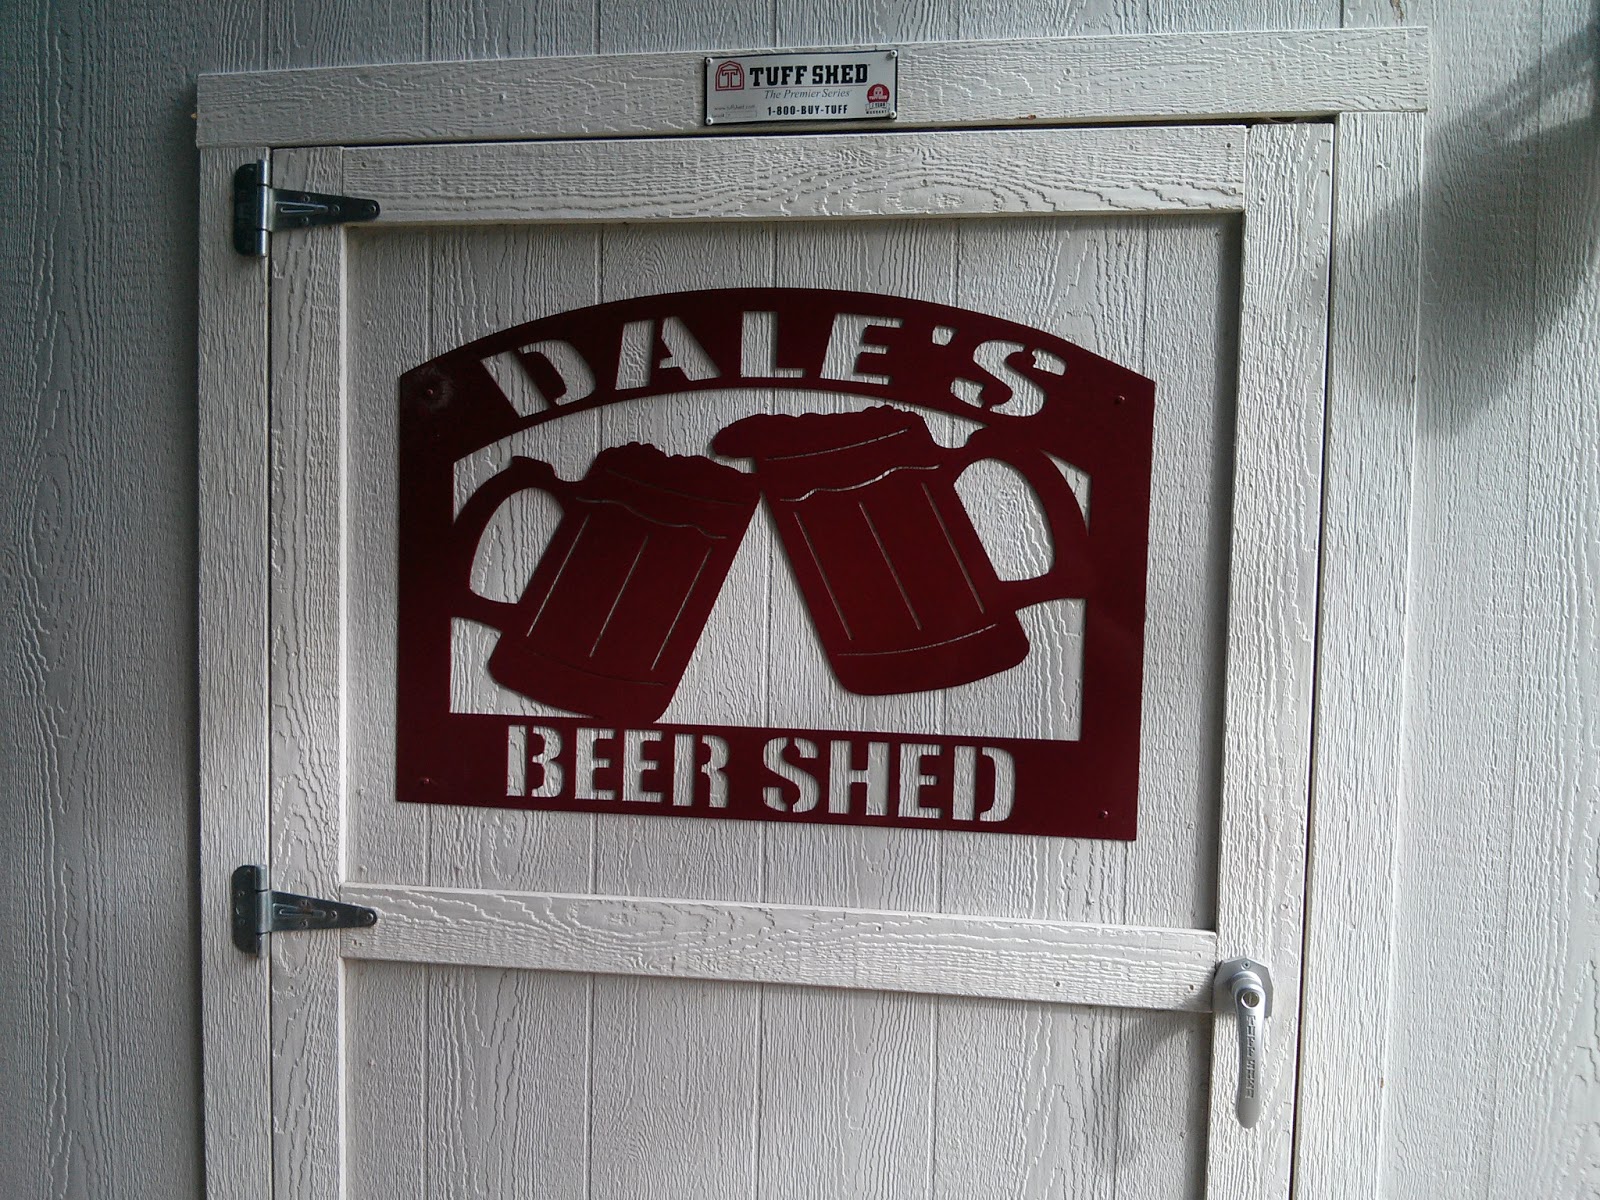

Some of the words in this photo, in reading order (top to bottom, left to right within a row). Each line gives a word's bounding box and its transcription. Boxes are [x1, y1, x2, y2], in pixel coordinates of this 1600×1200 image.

[750, 66, 807, 86] TUFF
[812, 64, 868, 84] SHED
[764, 90, 782, 99] The
[783, 89, 821, 99] Premier
[822, 88, 850, 98] Series
[767, 105, 848, 116] 1-800-BUY-TUFF
[479, 310, 1067, 418] DALE'S
[506, 725, 730, 809] BEER
[762, 737, 1016, 823] SHED
